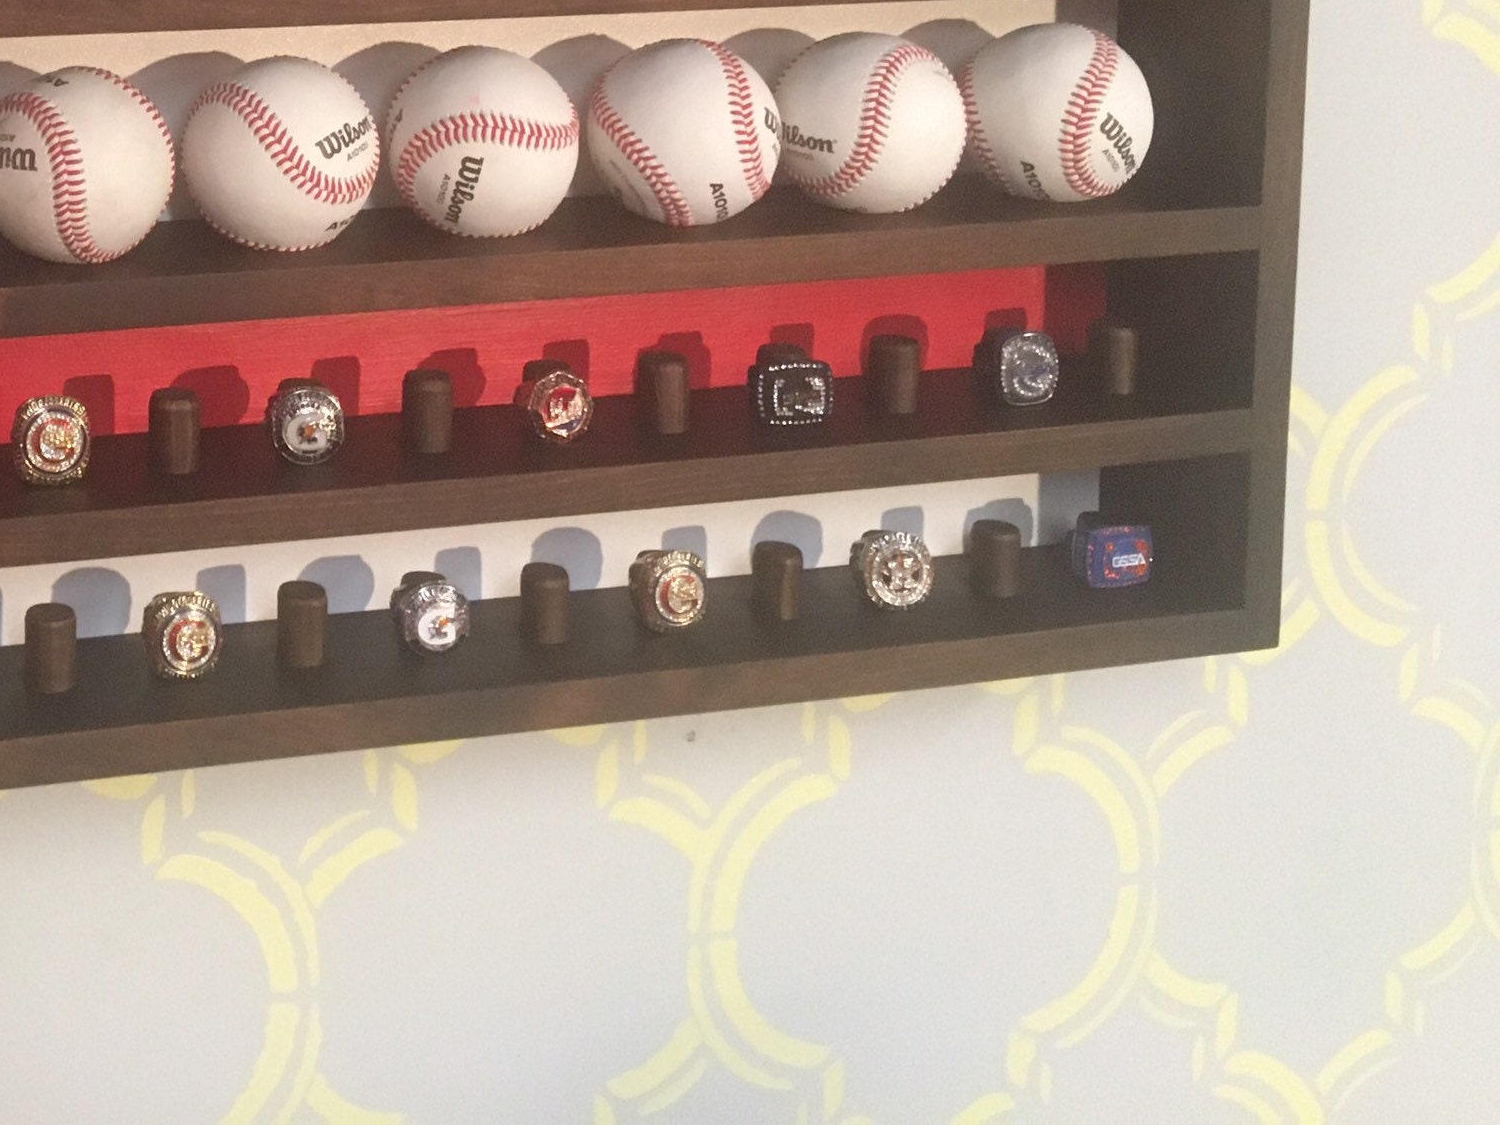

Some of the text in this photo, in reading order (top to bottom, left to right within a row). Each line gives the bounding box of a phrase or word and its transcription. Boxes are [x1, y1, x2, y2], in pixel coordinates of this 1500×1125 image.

[315, 116, 372, 159] Wilson
[1099, 112, 1136, 174] Wilson
[444, 155, 484, 224] Wilson
